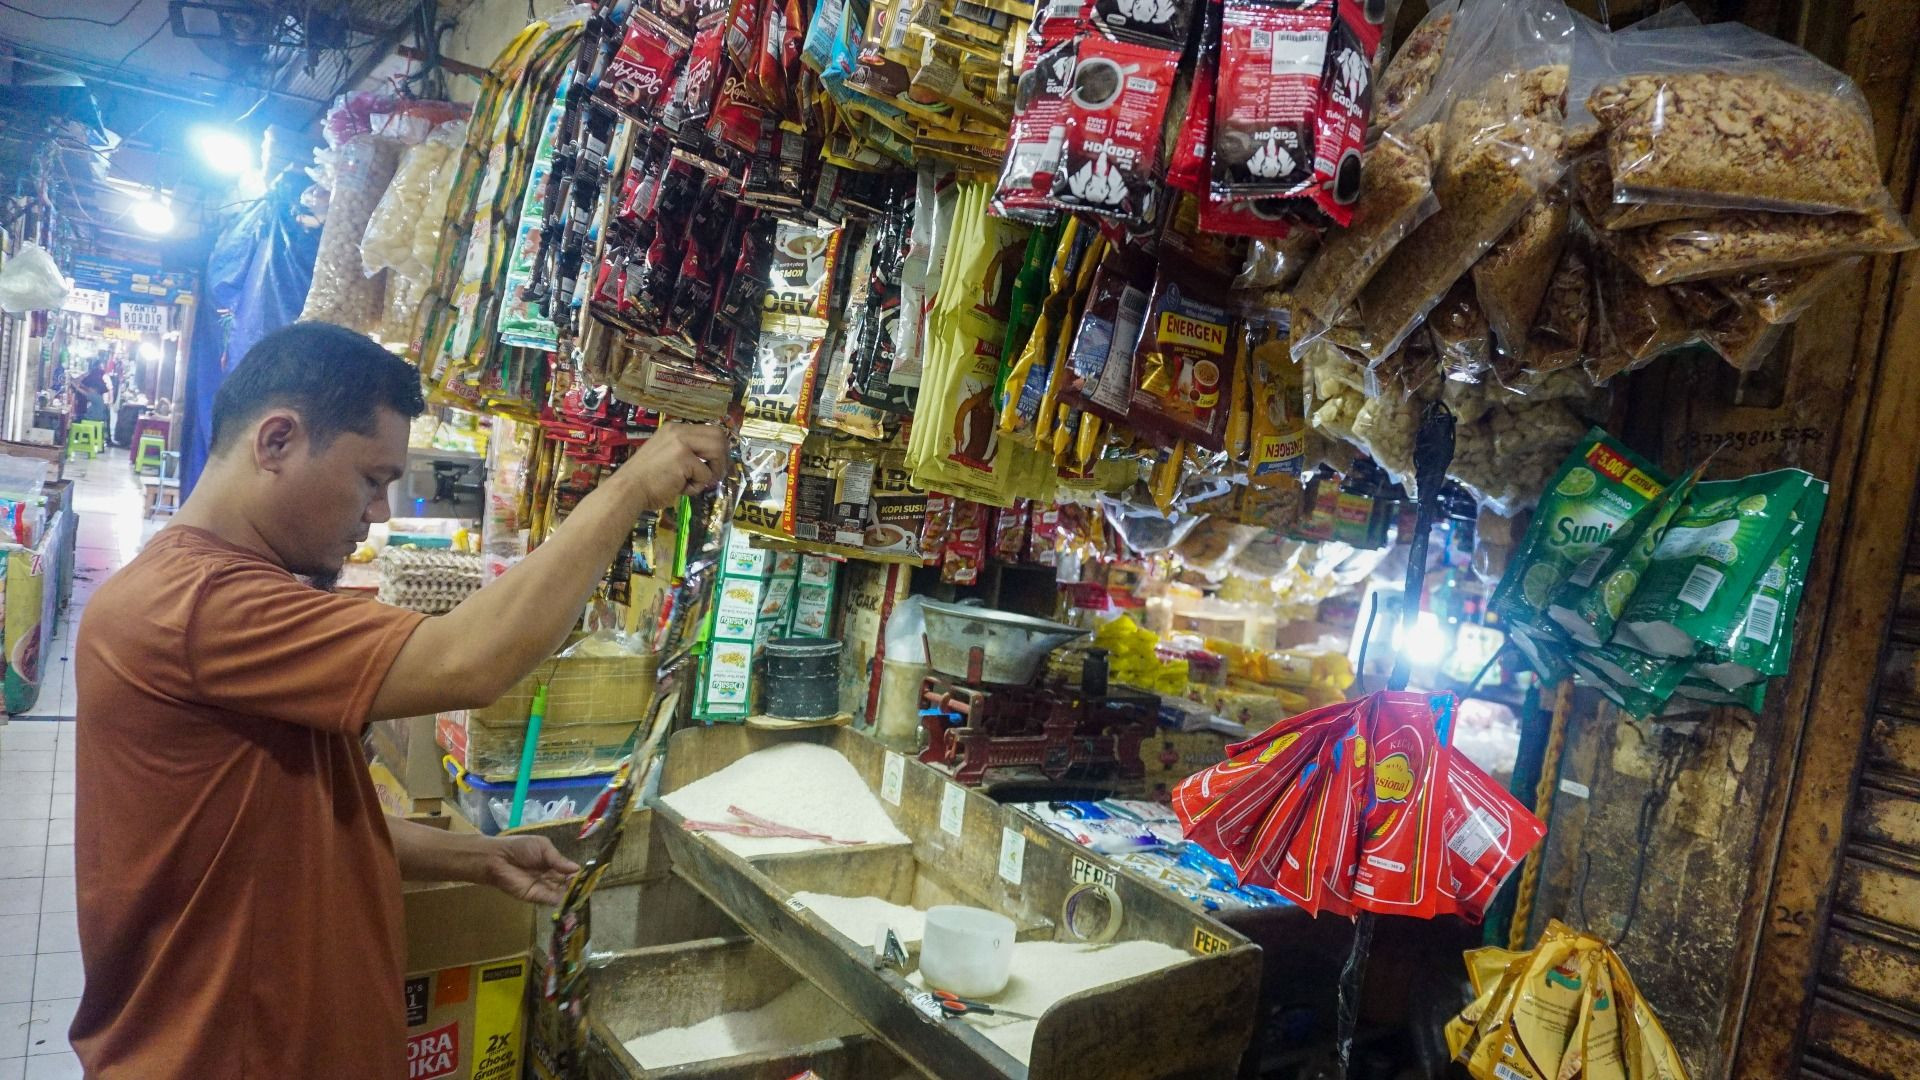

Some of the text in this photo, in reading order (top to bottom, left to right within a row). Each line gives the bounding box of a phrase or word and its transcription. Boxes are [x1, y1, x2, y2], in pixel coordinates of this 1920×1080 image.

[763, 289, 818, 315] ABC
[124, 312, 162, 325] BORDIR
[1167, 314, 1223, 345] ENERGEN
[745, 397, 796, 423] ABC
[797, 382, 811, 416] GRATIS
[784, 489, 793, 522] GRATIS
[881, 504, 903, 514] KOPI
[903, 504, 927, 514] SUSU
[1549, 516, 1613, 547] Sunli
[1375, 773, 1411, 794] asional
[407, 1033, 453, 1060] ORA
[409, 1053, 452, 1079] IKA
[478, 1050, 514, 1071] Choco
